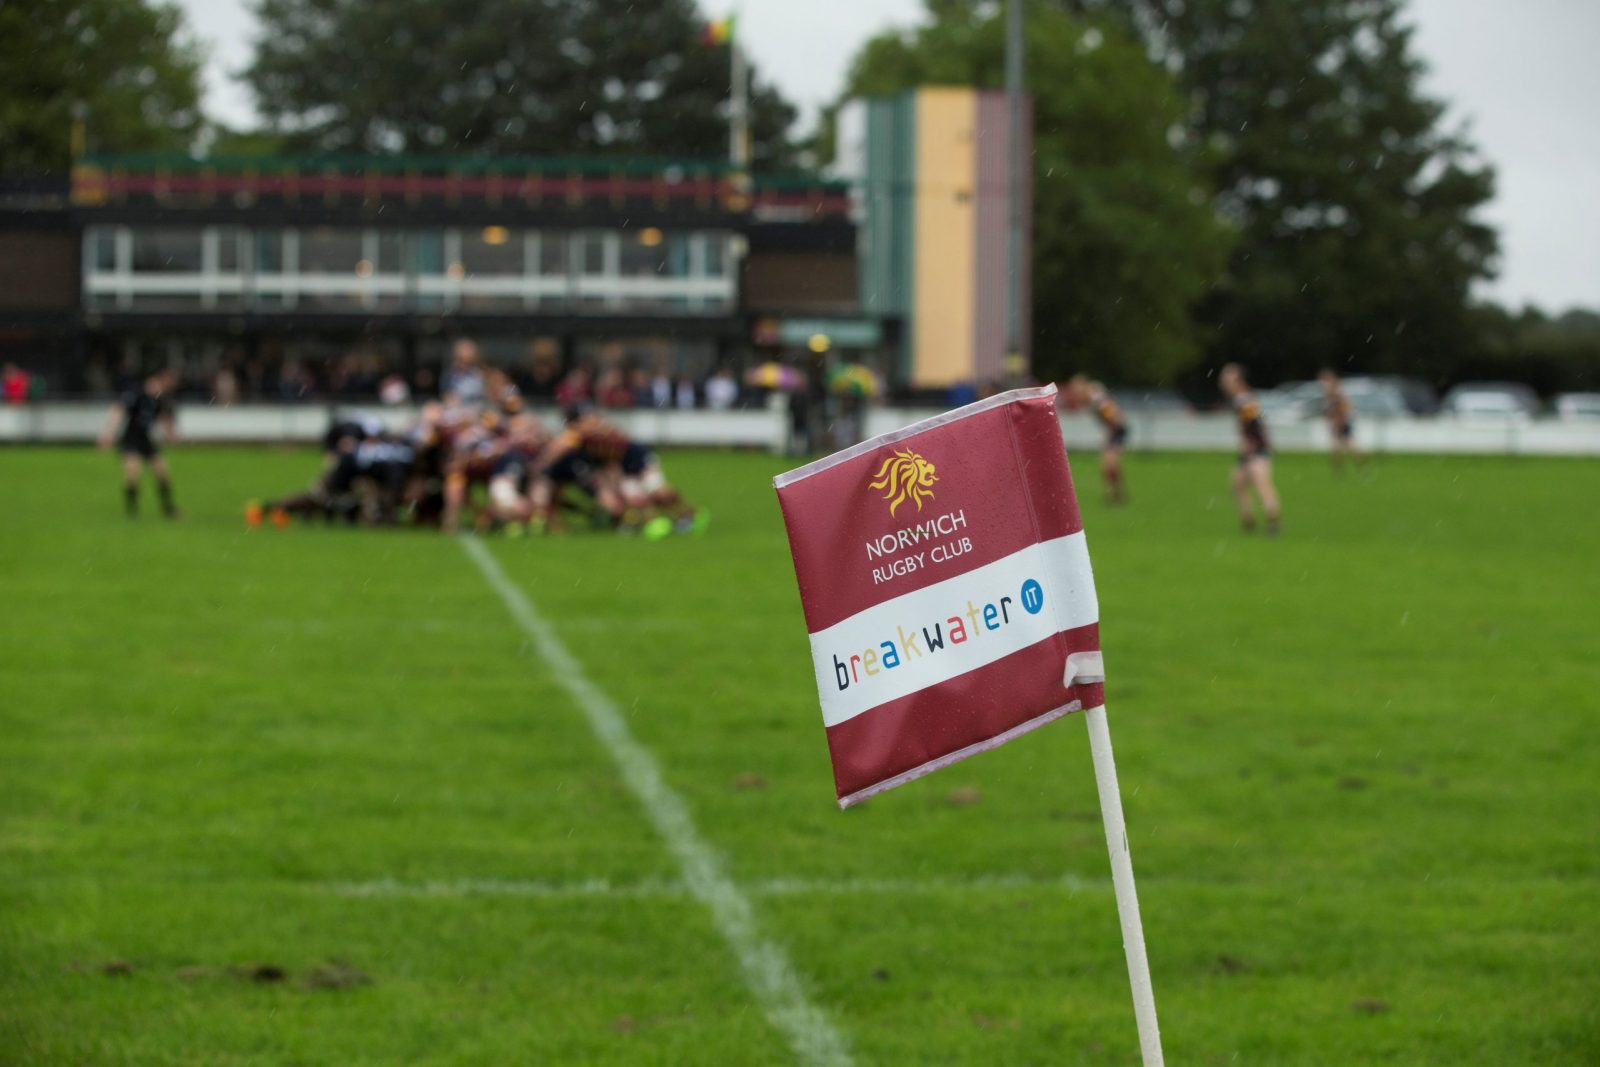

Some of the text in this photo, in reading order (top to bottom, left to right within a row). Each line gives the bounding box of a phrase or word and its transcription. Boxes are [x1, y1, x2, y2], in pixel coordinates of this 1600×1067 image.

[866, 509, 967, 561] NORWICH
[872, 537, 973, 585] RUGBY CLUB
[833, 587, 1038, 691] breakwater IT
